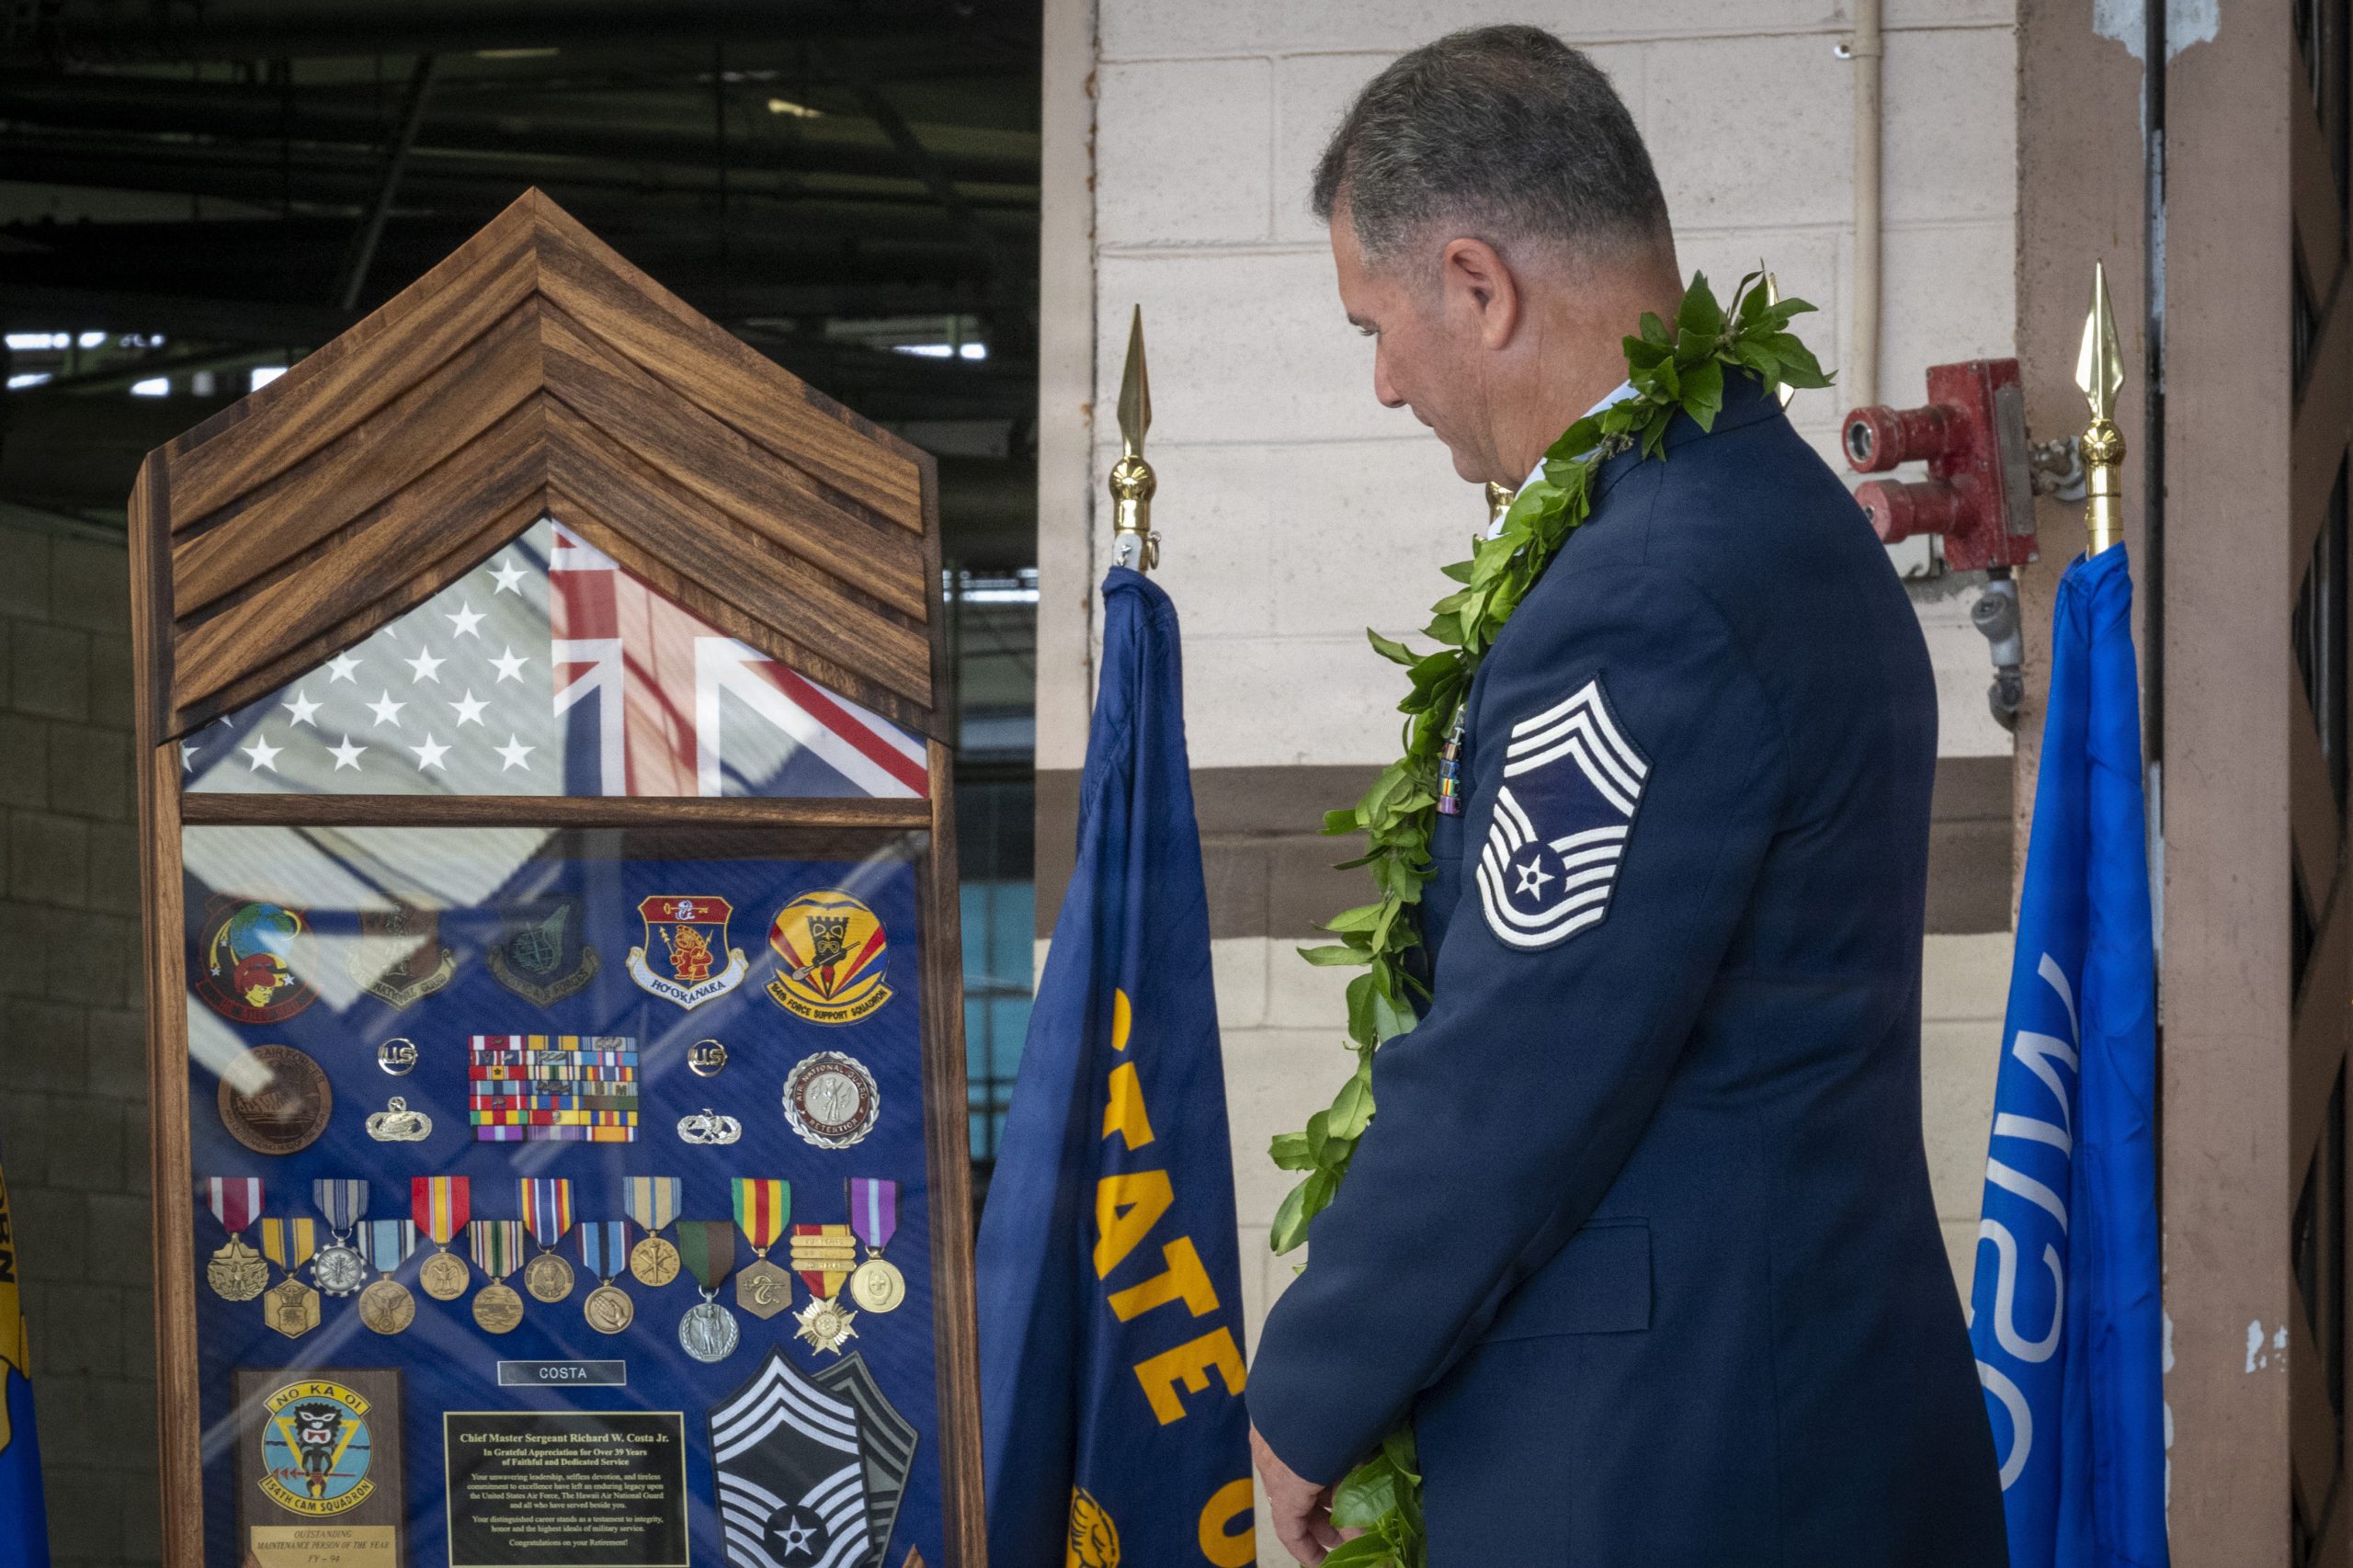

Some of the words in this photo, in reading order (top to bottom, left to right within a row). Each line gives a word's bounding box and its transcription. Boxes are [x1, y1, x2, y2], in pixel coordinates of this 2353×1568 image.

[788, 998, 812, 1017] FORCE
[813, 1009, 848, 1020] SUPPORT
[851, 988, 888, 1017] SQUADRON
[801, 1064, 845, 1083] NATIONAL
[847, 1071, 869, 1100] GUARD
[810, 1118, 858, 1133] RETENTION
[539, 1367, 587, 1379] COSTA
[276, 1389, 300, 1406] NO
[310, 1384, 335, 1397] KA
[345, 1394, 361, 1410] OI
[460, 1433, 487, 1443] Chief
[489, 1433, 524, 1443] Master
[525, 1433, 568, 1445] Sergeant
[570, 1433, 609, 1443] Richard
[610, 1433, 625, 1443] W.
[627, 1433, 654, 1443] Costa
[655, 1433, 670, 1443] Jr.
[528, 1449, 578, 1458] Appreciation
[502, 1458, 510, 1466] of
[512, 1458, 543, 1466] Faithful
[544, 1458, 559, 1466] and
[561, 1458, 600, 1466] Dedicated
[600, 1458, 631, 1466] Service
[529, 1473, 565, 1482] leadership,
[593, 1483, 623, 1491] enduring
[623, 1483, 645, 1491] legacy
[646, 1483, 664, 1491] upon
[264, 1478, 292, 1504] 154TH
[294, 1498, 317, 1512] CAM
[320, 1482, 369, 1512] SQUADRON
[611, 1501, 627, 1510] you.
[293, 1530, 353, 1539] OUTSTANDING
[257, 1541, 310, 1550] MAINTENANCE
[311, 1541, 340, 1550] PERSON
[341, 1541, 350, 1550] OF
[508, 1539, 562, 1548] Congratulations
[308, 1554, 319, 1563] FY
